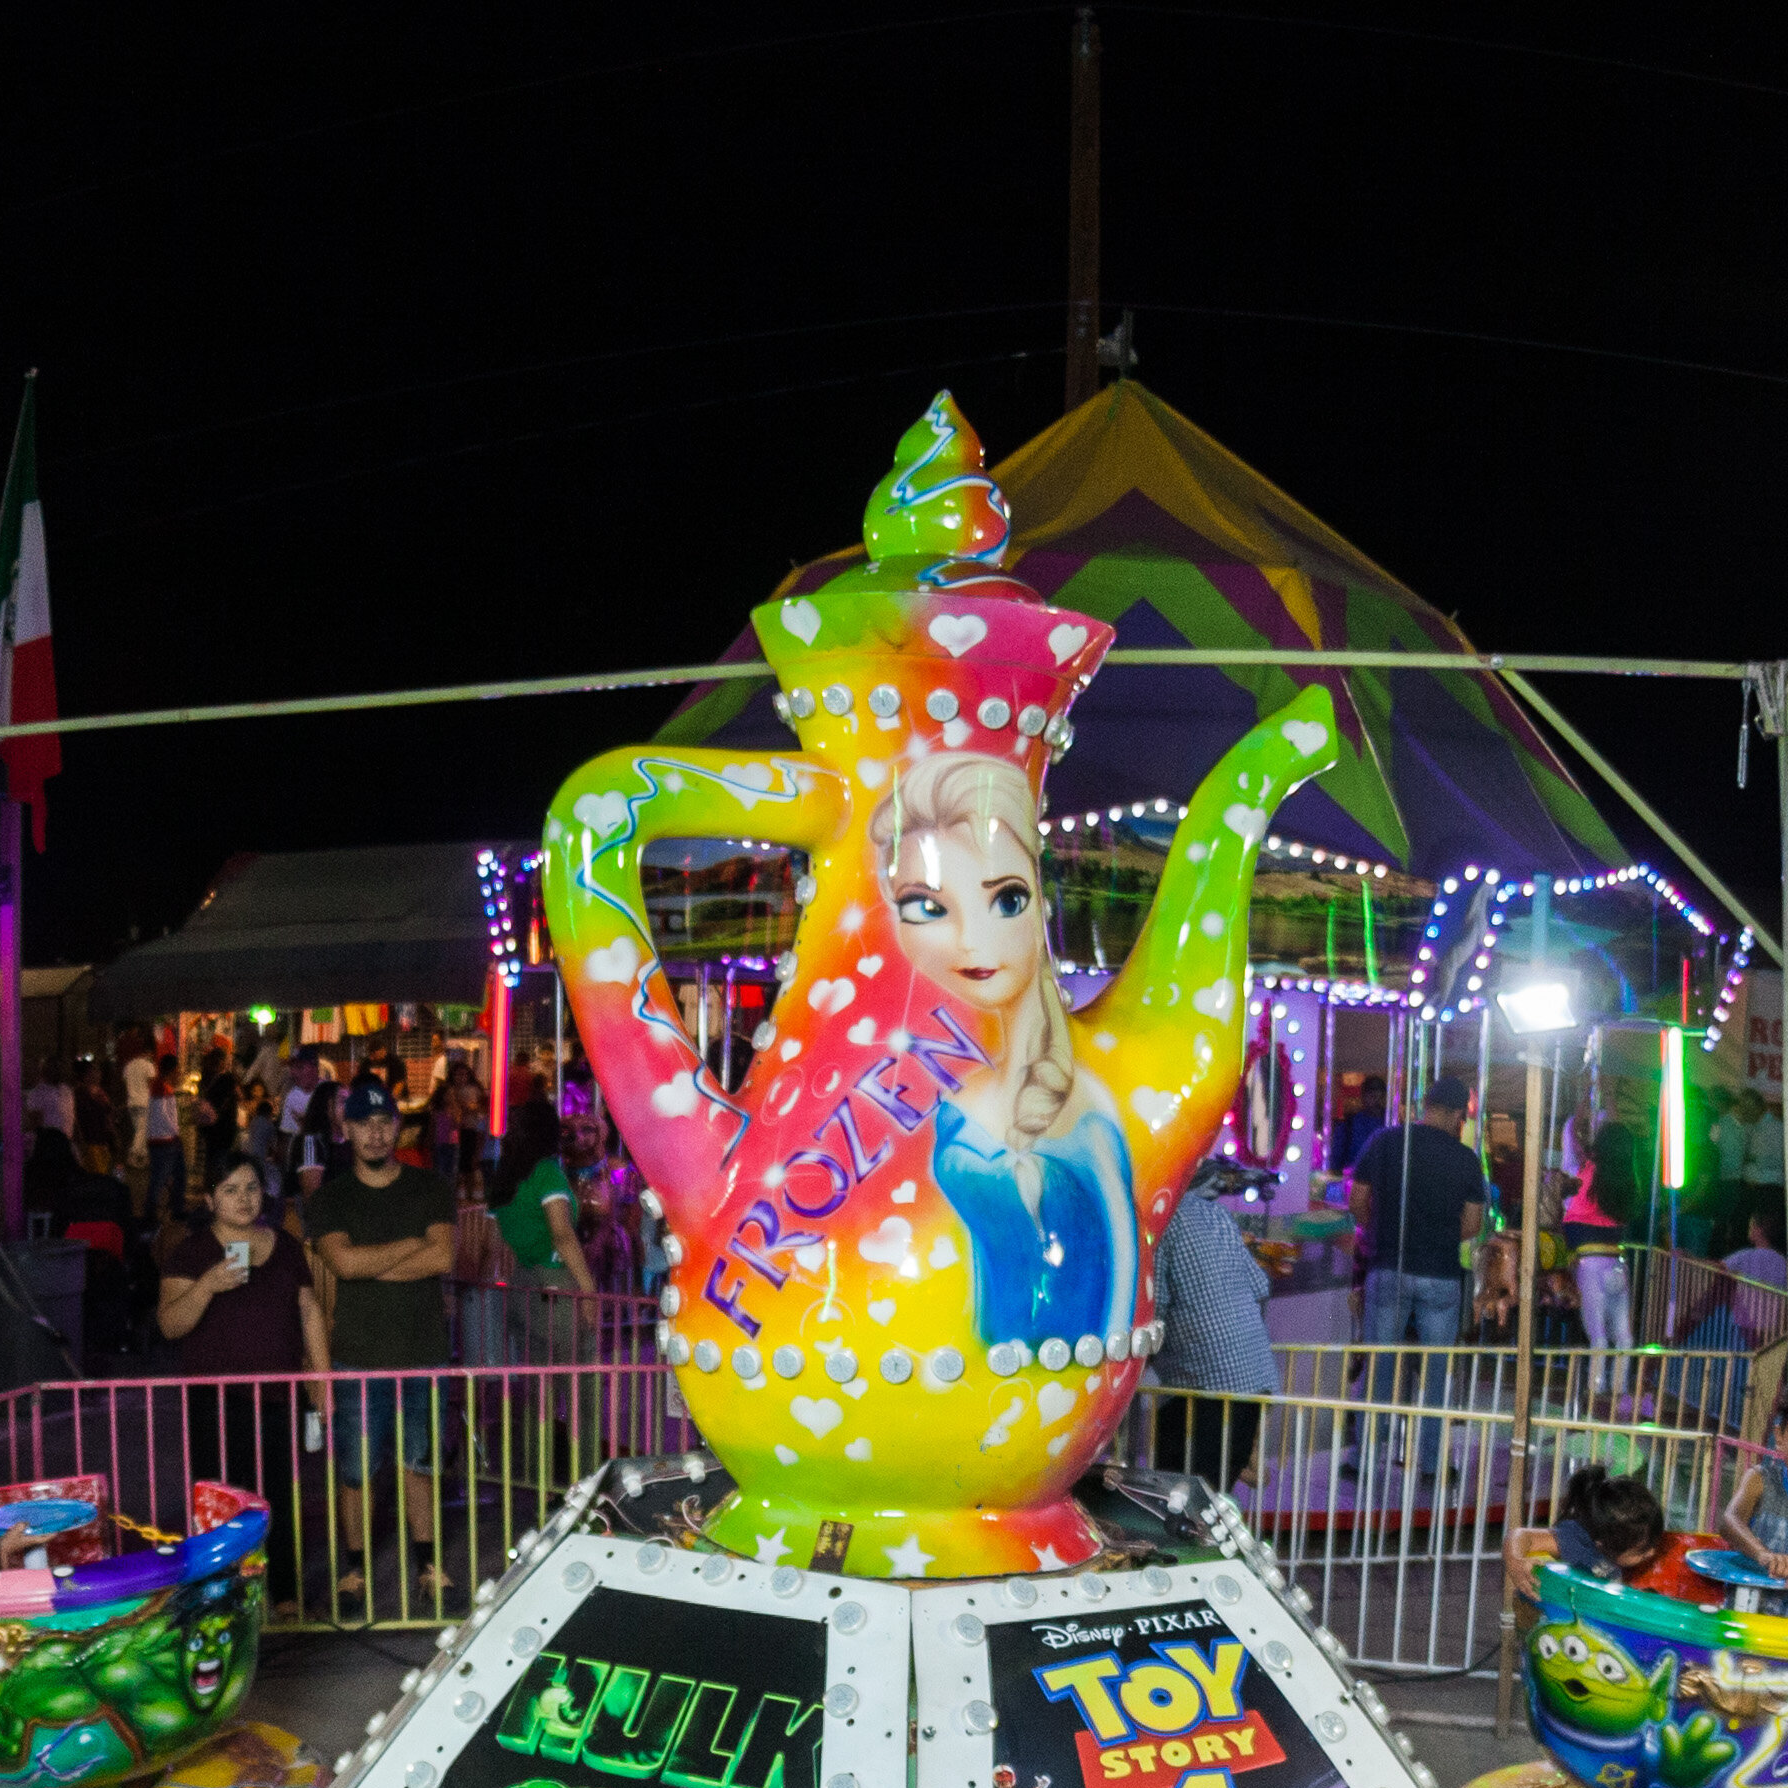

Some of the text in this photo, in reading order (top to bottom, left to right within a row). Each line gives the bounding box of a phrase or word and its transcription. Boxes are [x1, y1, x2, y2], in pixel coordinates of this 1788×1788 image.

[703, 1005, 996, 1339] FROZEN
[1134, 1609, 1221, 1635] PIXAR
[1033, 1637, 1248, 1747] TOY
[1100, 1728, 1256, 1779] STORY
